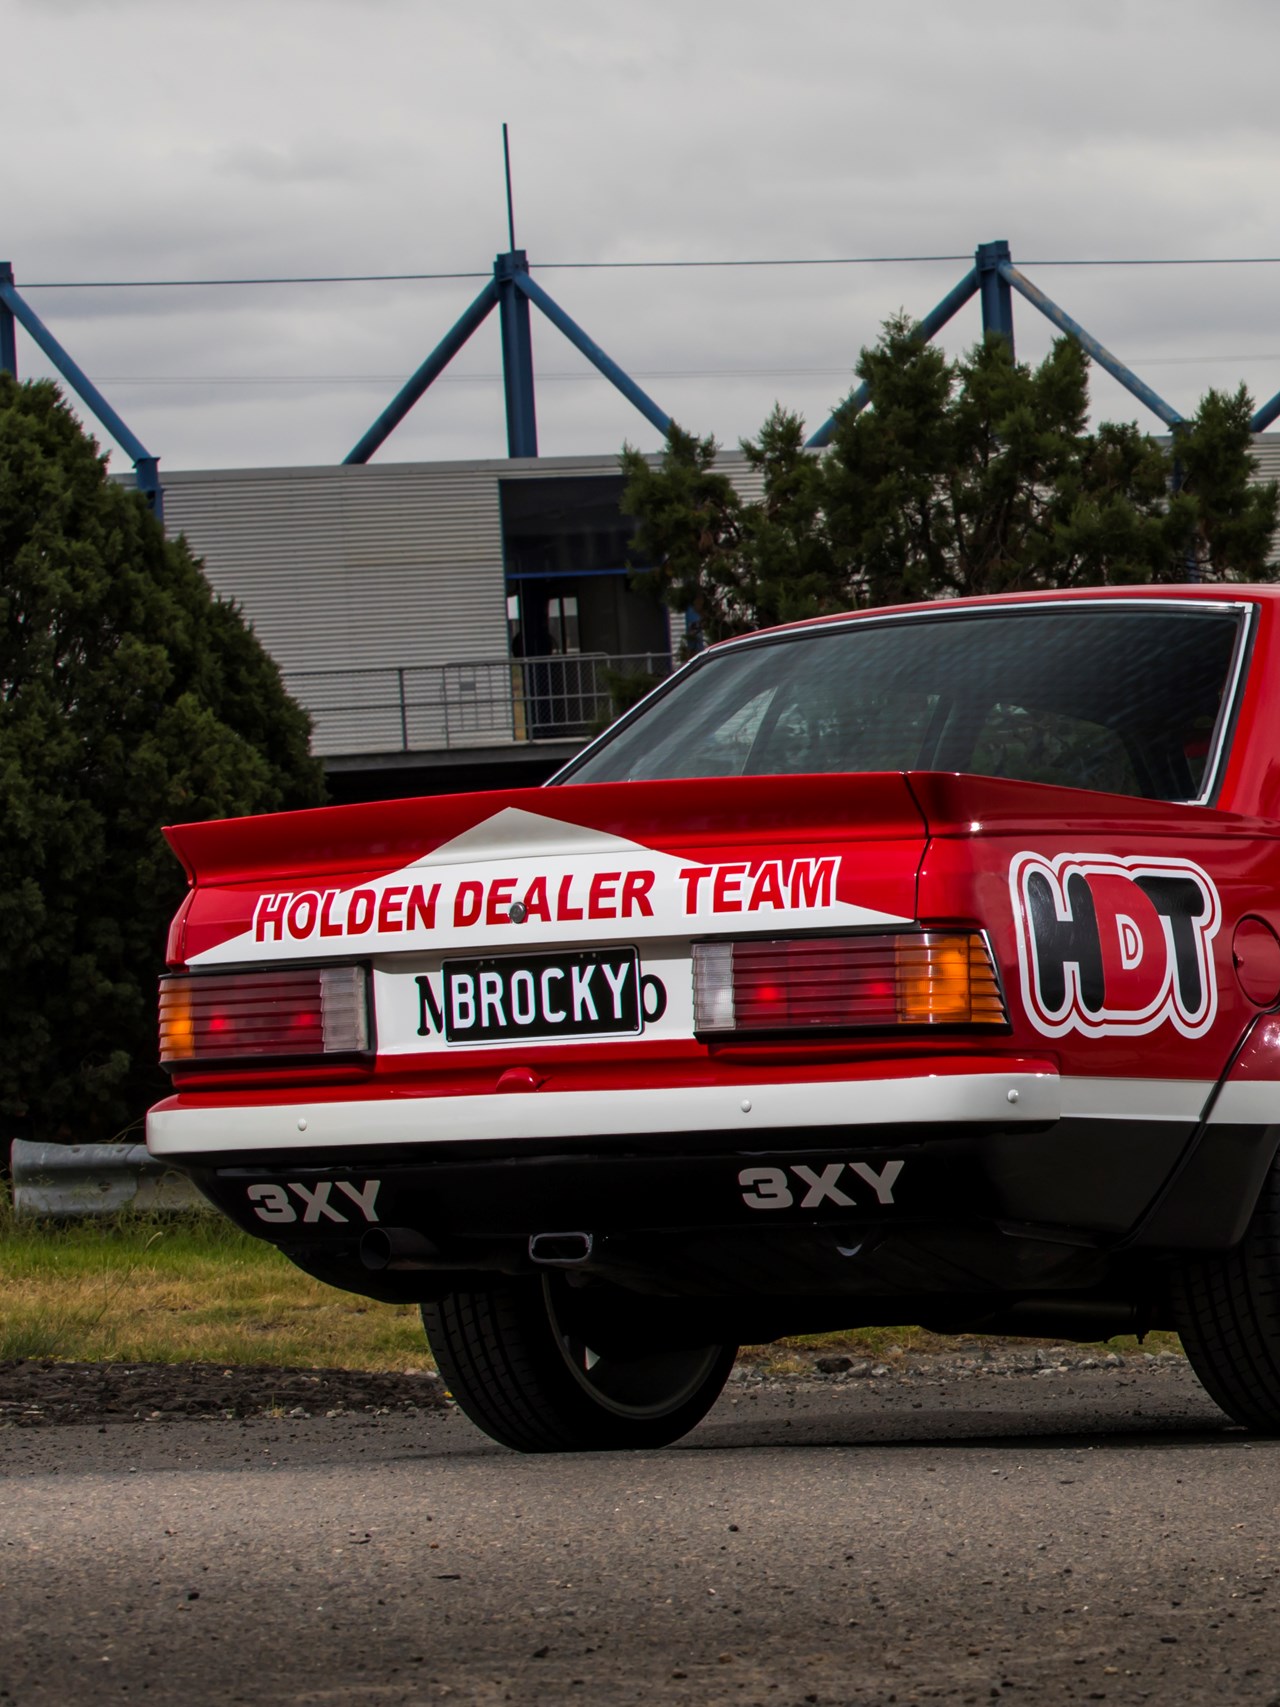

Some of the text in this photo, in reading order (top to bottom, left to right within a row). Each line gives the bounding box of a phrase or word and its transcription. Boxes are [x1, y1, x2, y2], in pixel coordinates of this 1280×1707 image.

[255, 857, 839, 943] HOLDEN DEALER TEAM
[1020, 861, 1212, 1026] HDT
[450, 962, 631, 1030] BROCKY
[247, 1179, 382, 1223] 3XY
[738, 1160, 905, 1210] 3XY
